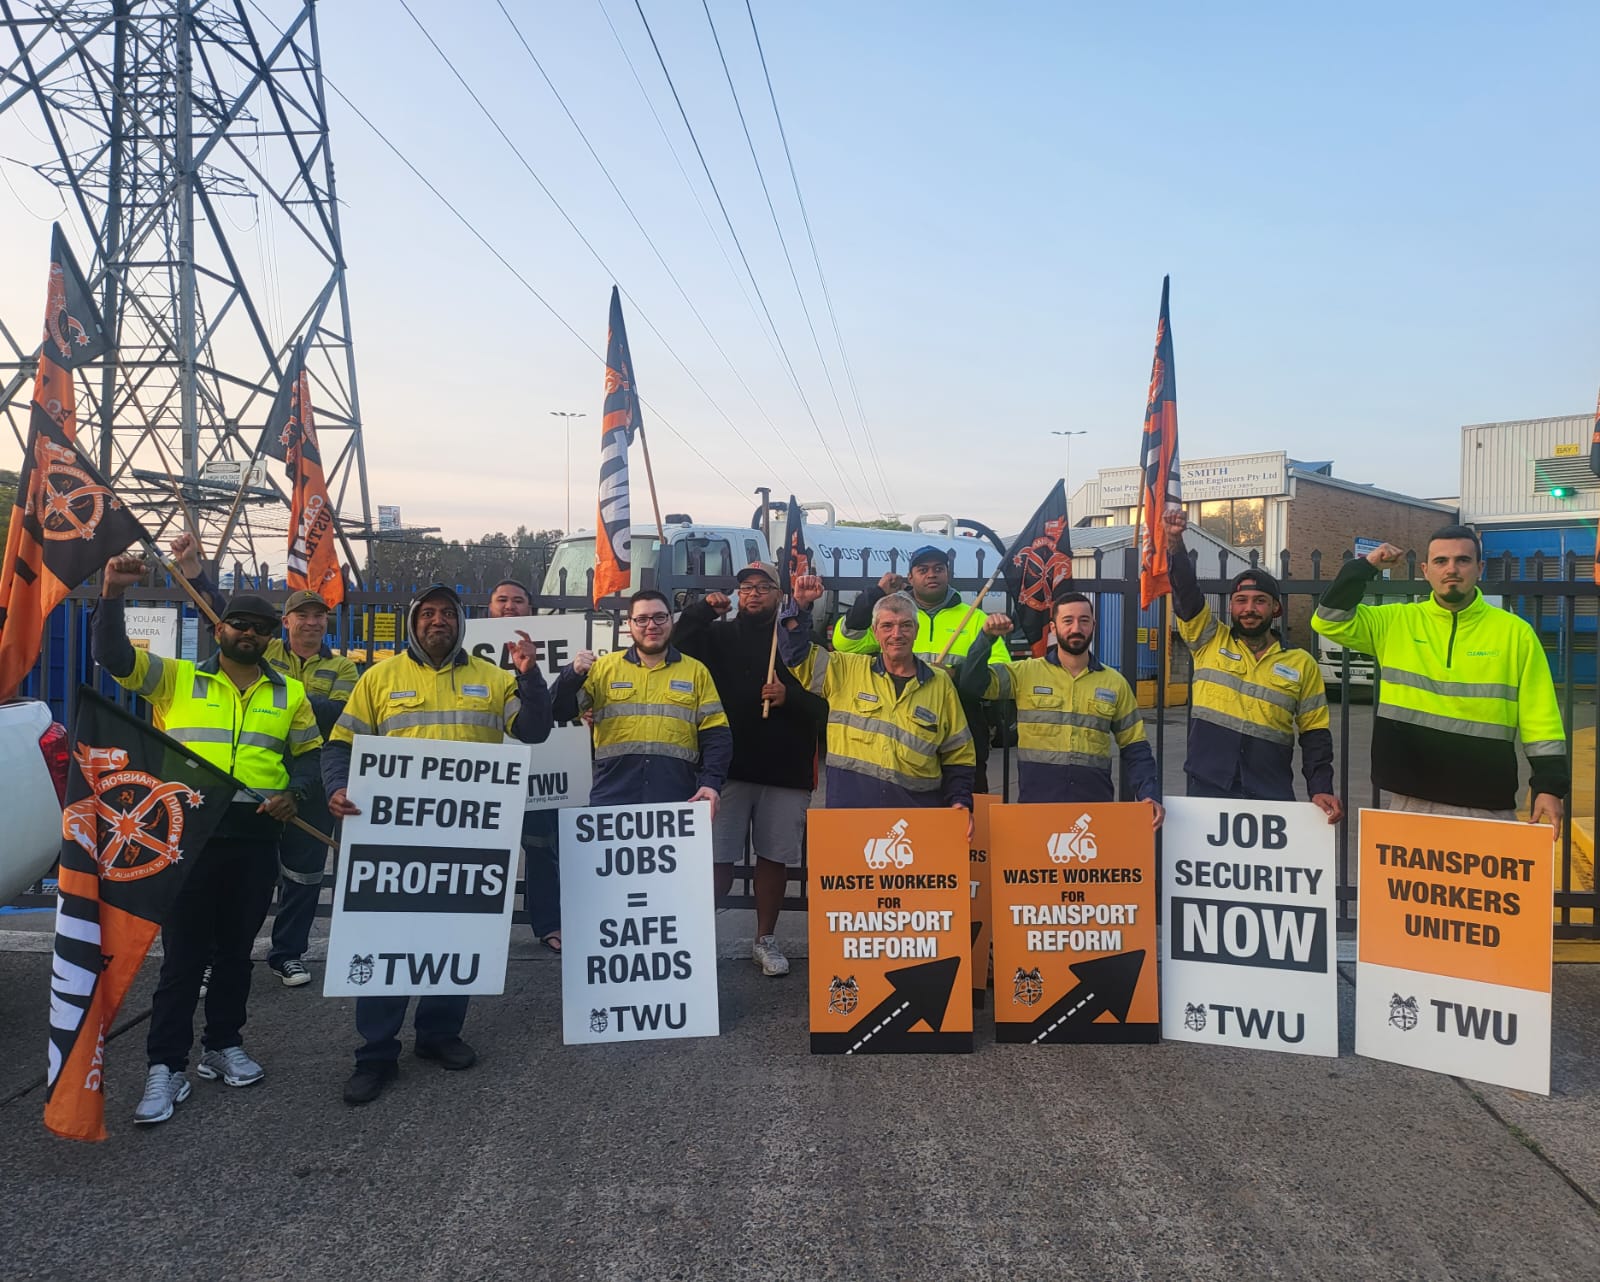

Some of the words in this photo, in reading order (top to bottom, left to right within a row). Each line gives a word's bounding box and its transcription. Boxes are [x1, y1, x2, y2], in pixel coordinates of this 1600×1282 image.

[1188, 467, 1228, 479] SMITH
[1206, 475, 1246, 486] Engineers
[1248, 472, 1260, 482] Pty
[1262, 472, 1278, 480] Ltd
[819, 544, 861, 561] Gras
[128, 628, 160, 636] CAMERA
[151, 616, 167, 624] ARE
[359, 753, 414, 779] PUT
[421, 757, 522, 785] PEOPLE
[528, 772, 568, 796] TWU
[370, 796, 502, 830] BEFORE
[576, 809, 695, 842] SECURE
[1207, 812, 1288, 850] JOB
[596, 844, 677, 877] JOBS
[1004, 868, 1058, 884] WASTE
[1063, 868, 1142, 884] WORKERS
[1376, 843, 1535, 882] TRANSPORT
[350, 860, 504, 896] PROFITS
[820, 875, 874, 890] WASTE
[880, 874, 958, 890] WORKERS
[1175, 859, 1323, 895] SECURITY
[878, 898, 901, 909] FOR
[1061, 891, 1085, 902] FOR
[1387, 878, 1520, 916] WORKERS
[826, 910, 952, 932] TRANSPORT
[1010, 904, 1138, 926] TRANSPORT
[1405, 914, 1500, 948] UNITED
[600, 916, 678, 948] SAFE
[844, 936, 937, 959] REFORM
[1027, 930, 1122, 951] REFORM
[1183, 902, 1317, 963] NOW
[378, 952, 480, 986] TWU
[587, 950, 692, 985] ROADS
[610, 1003, 686, 1033] TWU
[1209, 1003, 1305, 1044] TWU
[1430, 999, 1518, 1046] TWU
